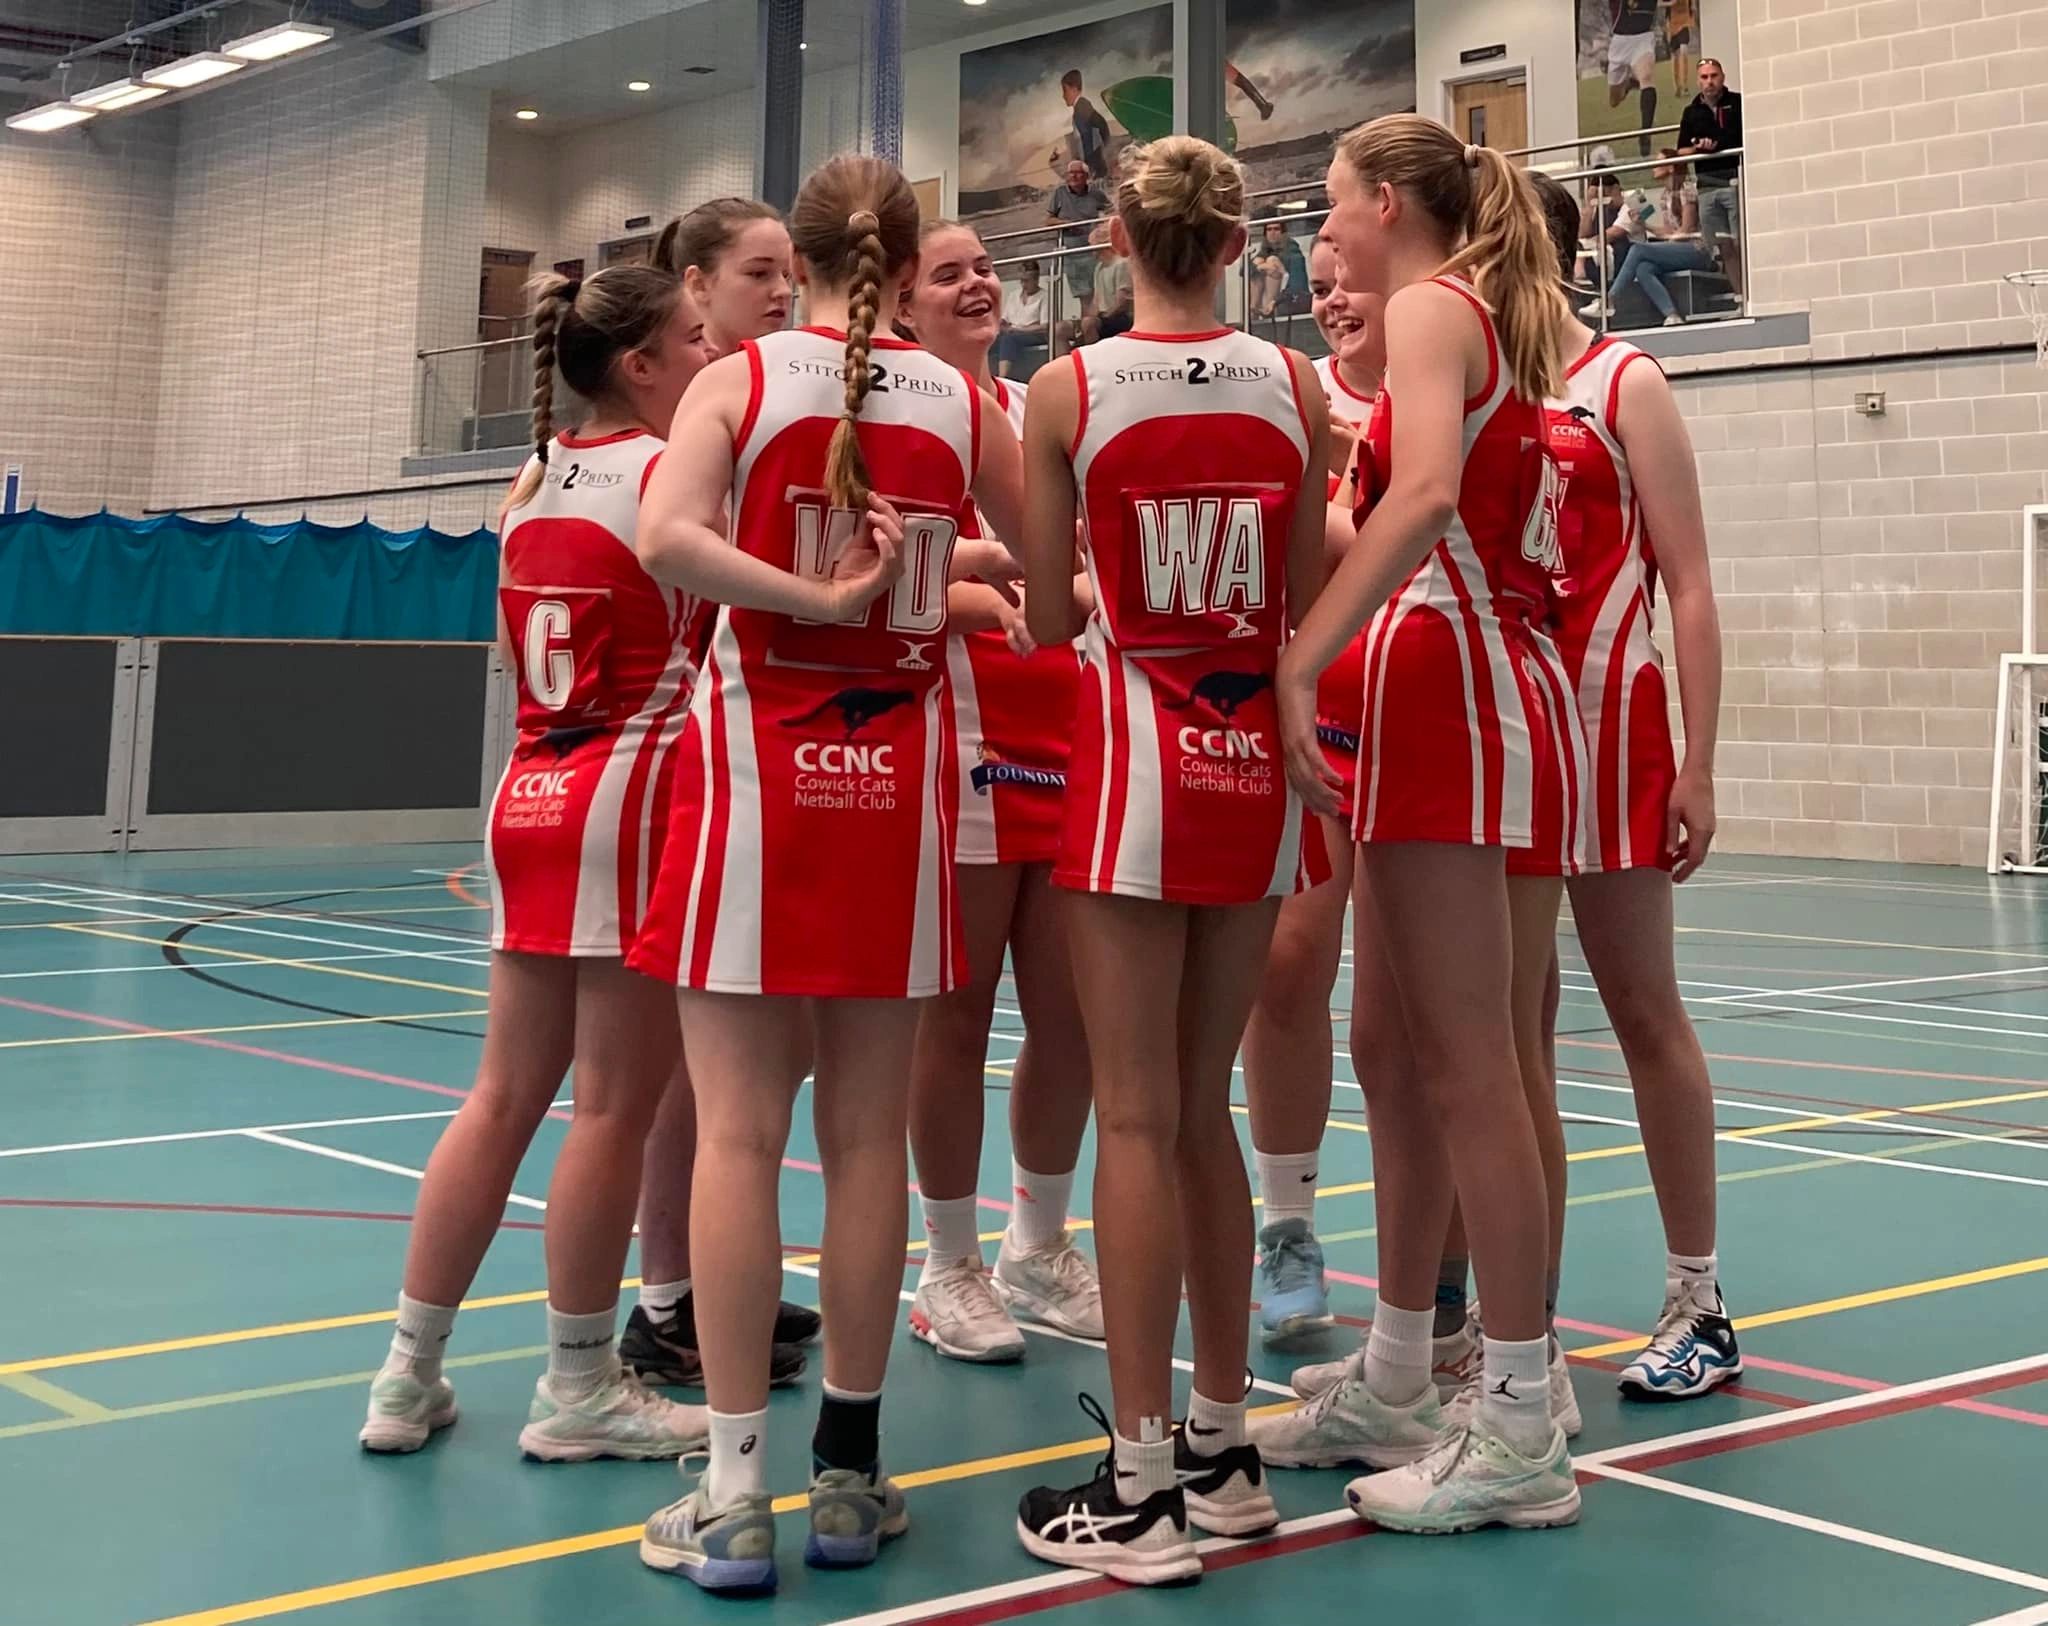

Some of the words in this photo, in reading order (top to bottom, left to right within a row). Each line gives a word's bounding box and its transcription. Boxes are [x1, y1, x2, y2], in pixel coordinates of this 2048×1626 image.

[869, 362, 889, 393] 2
[893, 373, 957, 397] PRINT
[1115, 368, 1183, 384] STITCH
[1187, 358, 1210, 385] 2
[1212, 362, 1271, 379] PRINT
[1551, 424, 1588, 439] CCNC
[562, 463, 580, 490] 2
[579, 469, 625, 484] PRINT
[1135, 497, 1266, 616] WA
[524, 599, 575, 711] C
[1178, 726, 1270, 760] CCNC
[793, 742, 894, 774] CCNC
[1179, 756, 1235, 776] Cowick
[1239, 761, 1272, 778] Cats
[510, 769, 577, 799] CCNC
[794, 773, 856, 792] Cowick
[860, 776, 896, 792] Cats
[1180, 774, 1235, 793] Netball
[1238, 778, 1273, 796] Club
[794, 791, 853, 809] Netball
[858, 794, 896, 810] Club
